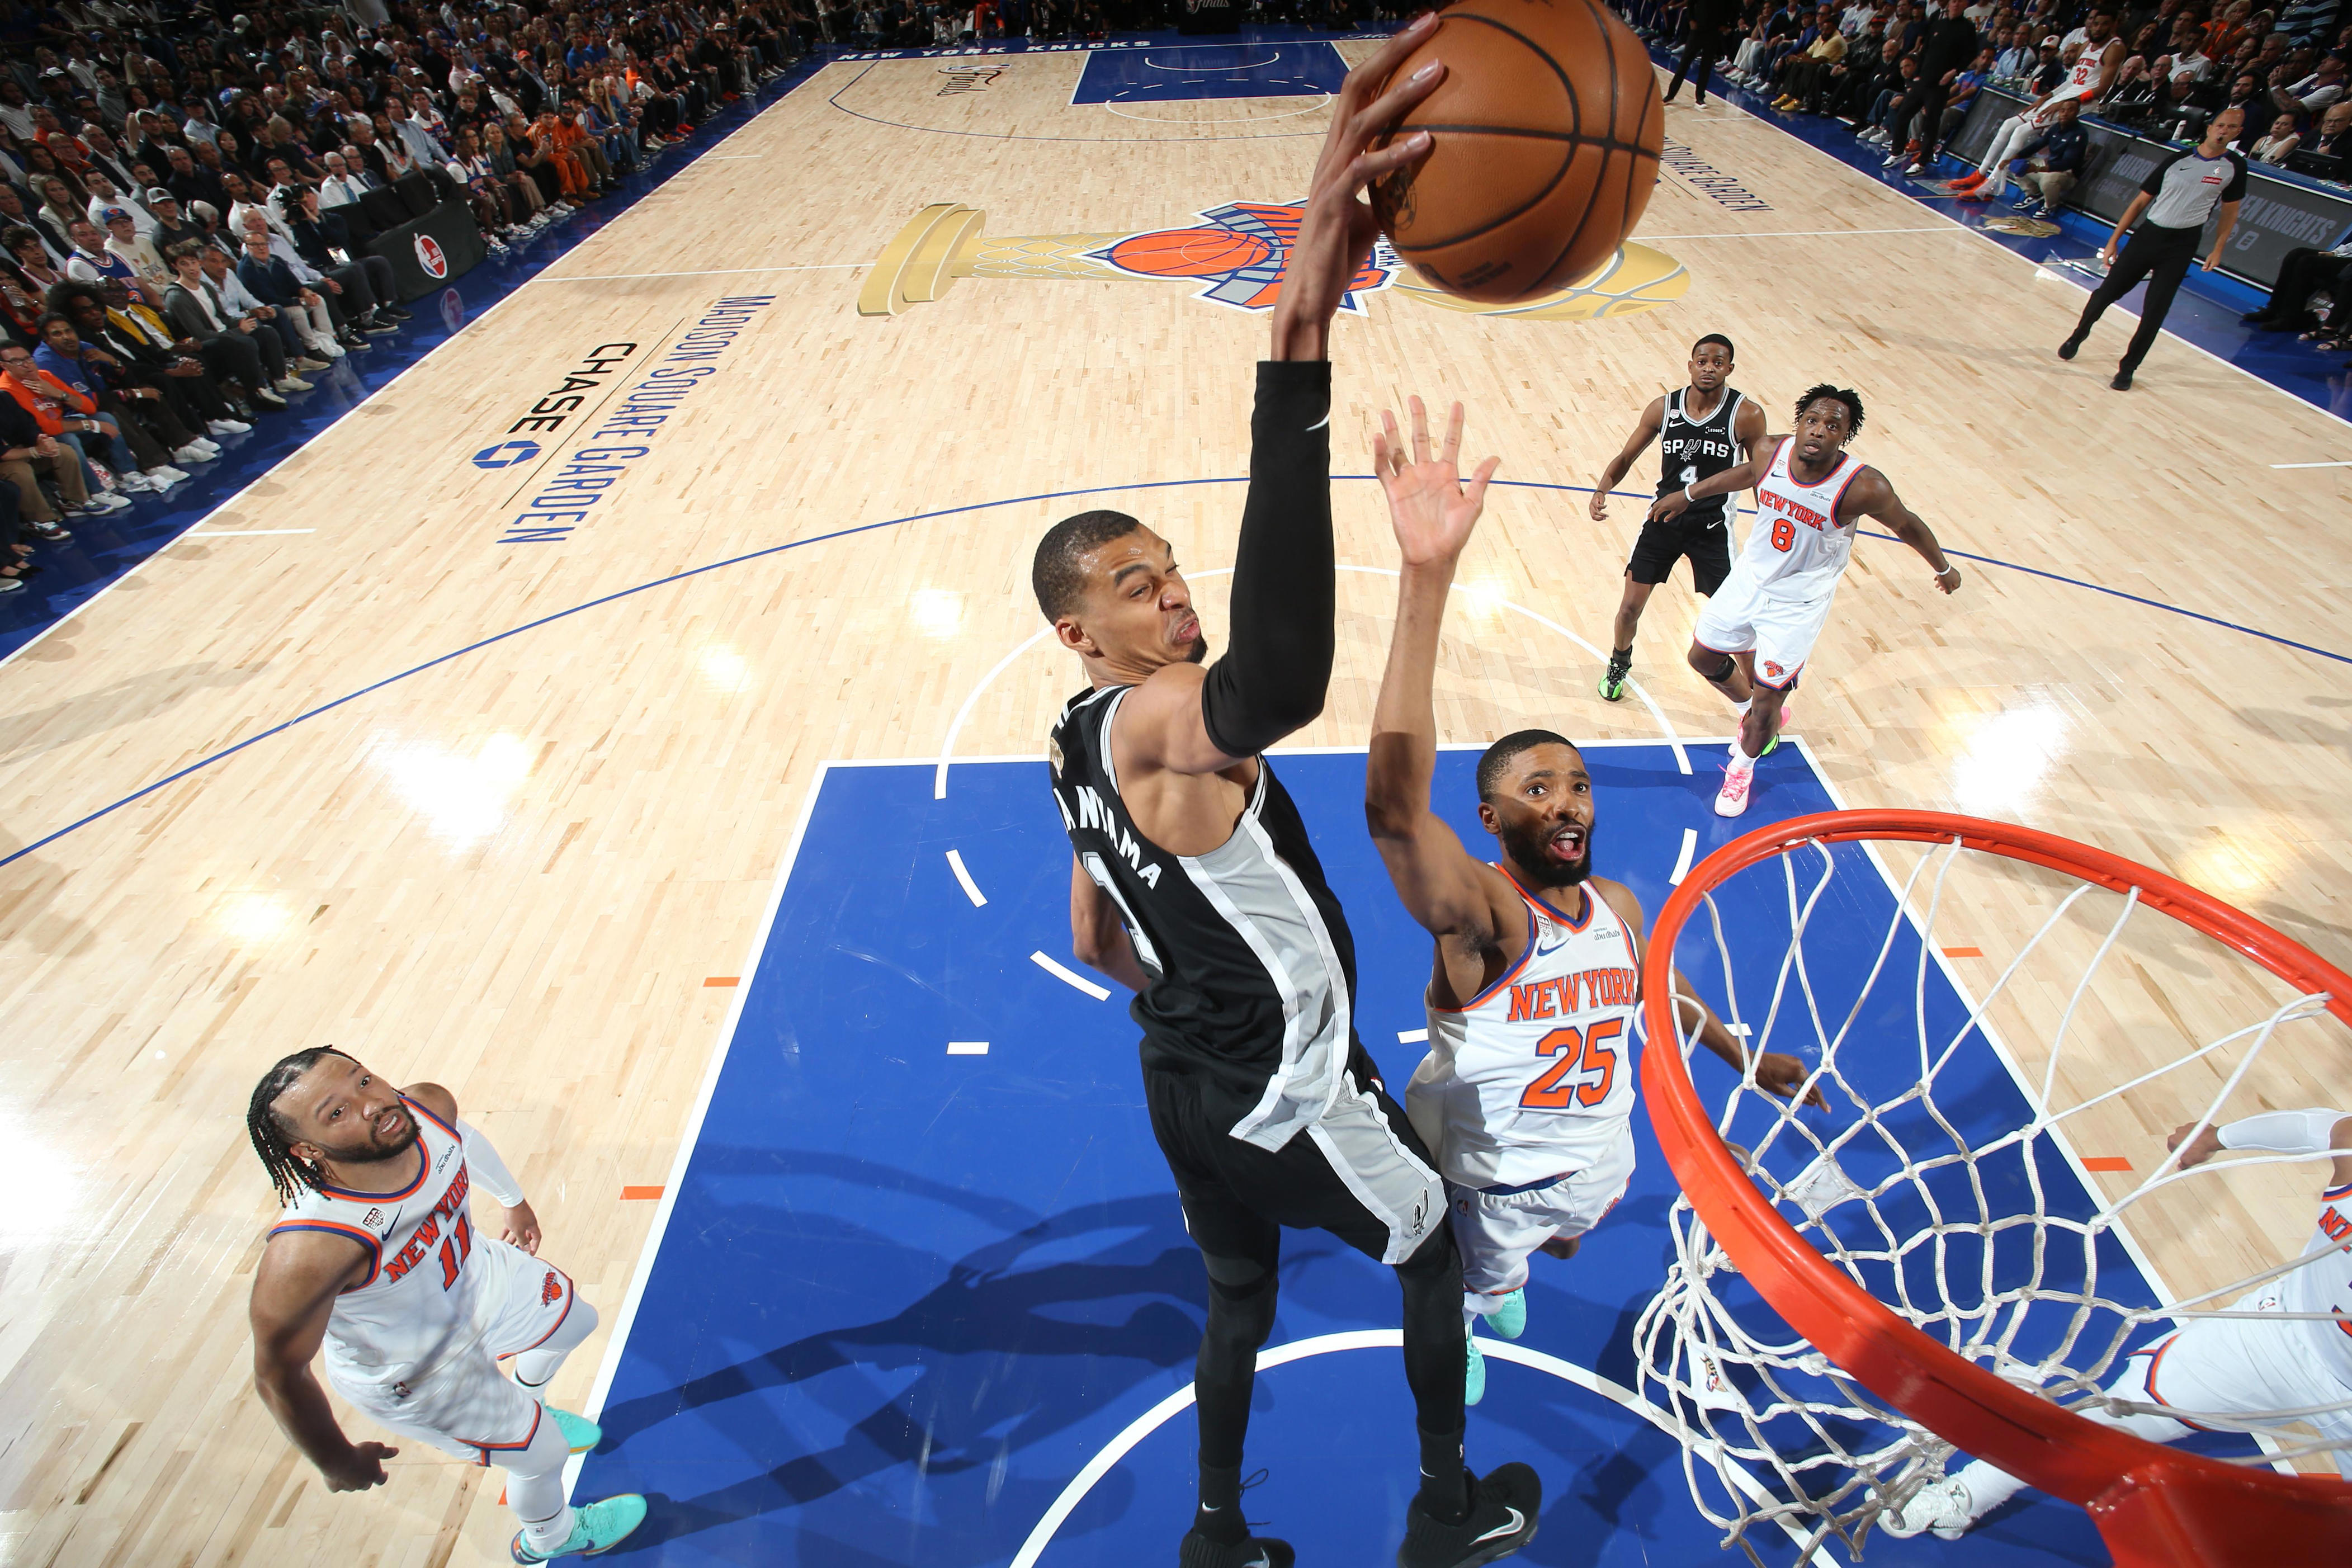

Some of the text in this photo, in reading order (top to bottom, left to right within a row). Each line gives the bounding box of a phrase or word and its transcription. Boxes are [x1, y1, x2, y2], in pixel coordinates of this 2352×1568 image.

[837, 41, 1151, 60] NEW YORK KNICKS
[938, 69, 1002, 97] Finals
[2073, 67, 2088, 85] 32
[1660, 147, 1775, 211] SQUARE GARDEN
[2255, 201, 2338, 245] KNIGHTS
[507, 342, 638, 434] CHASE
[495, 295, 777, 545] MADISON SQUARE GARDEN
[1663, 439, 1729, 462] SPURS
[1679, 465, 1698, 485] 4
[1759, 488, 1828, 532] NEW YORK
[1770, 518, 1796, 553] 8
[1053, 785, 1162, 890] ANYAMA
[1606, 929, 1621, 938] dhabi
[1507, 968, 1636, 1023] NEW YORK
[1518, 1017, 1624, 1109] 25
[438, 1161, 446, 1174] abu
[444, 1143, 456, 1163] dhabi
[363, 1210, 378, 1225] USA
[371, 1212, 385, 1229] 250
[383, 1212, 441, 1283] NEW
[438, 1211, 471, 1293] 11
